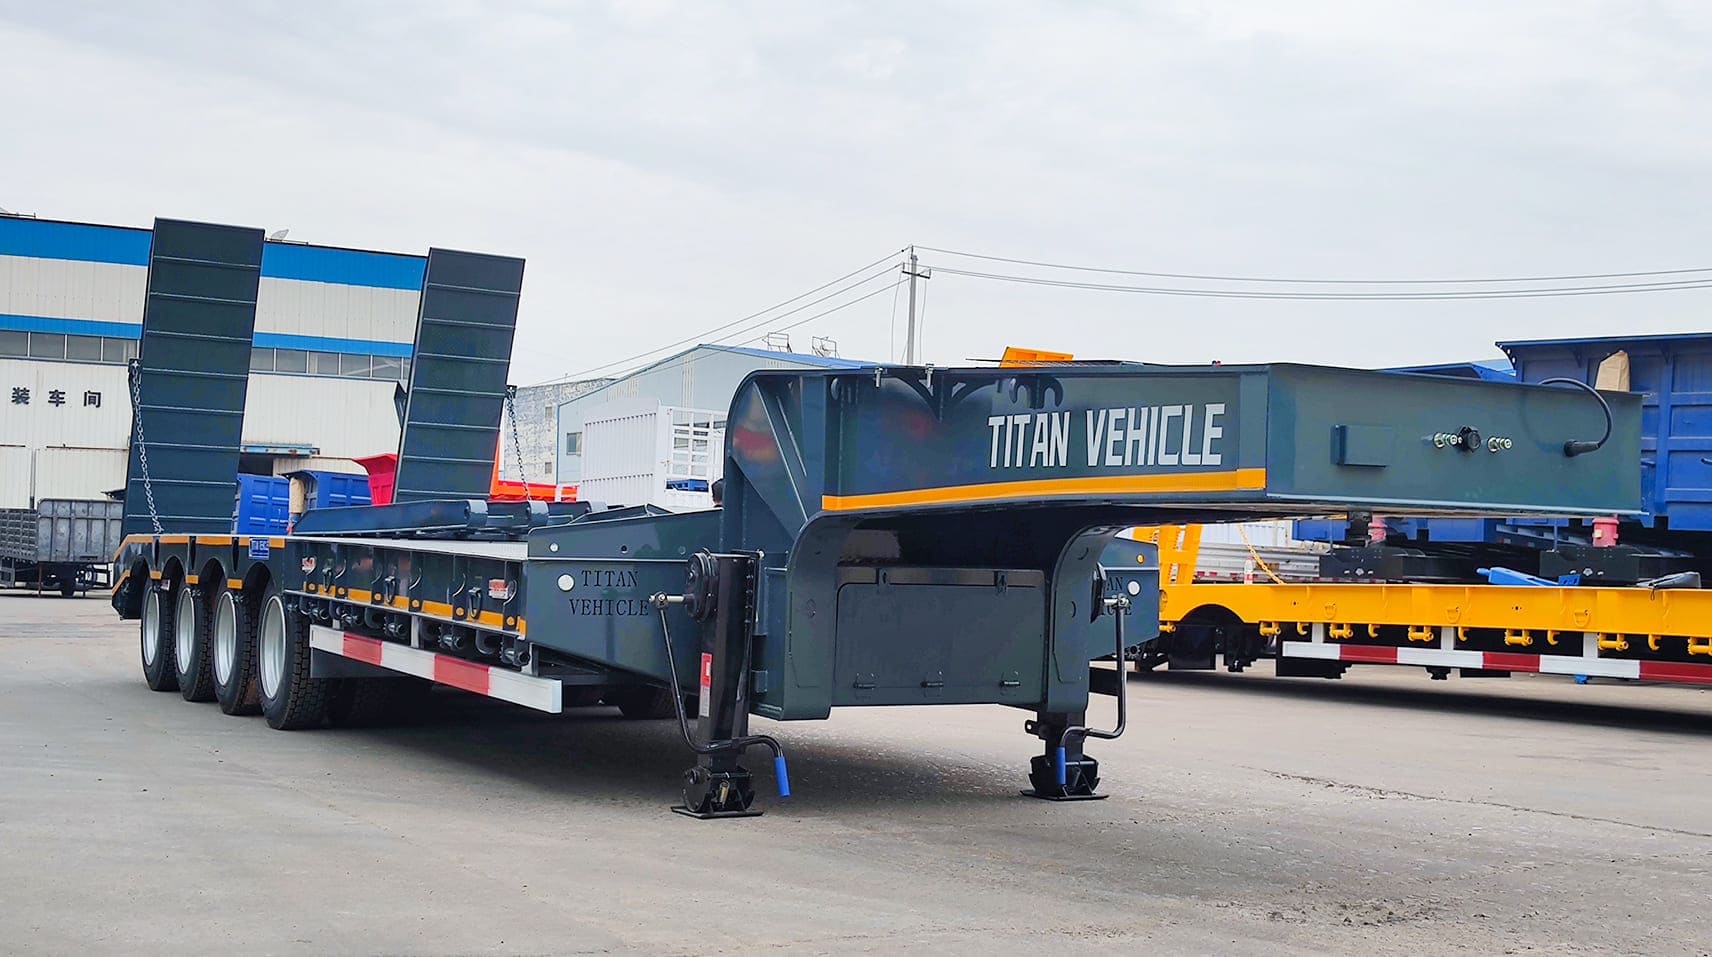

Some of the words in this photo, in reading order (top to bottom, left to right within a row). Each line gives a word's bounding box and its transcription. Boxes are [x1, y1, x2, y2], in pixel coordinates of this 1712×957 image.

[987, 411, 1072, 468] TITAN
[1085, 403, 1226, 467] VEHICLE
[581, 570, 639, 588] TITAN
[569, 599, 650, 617] VEHICLE
